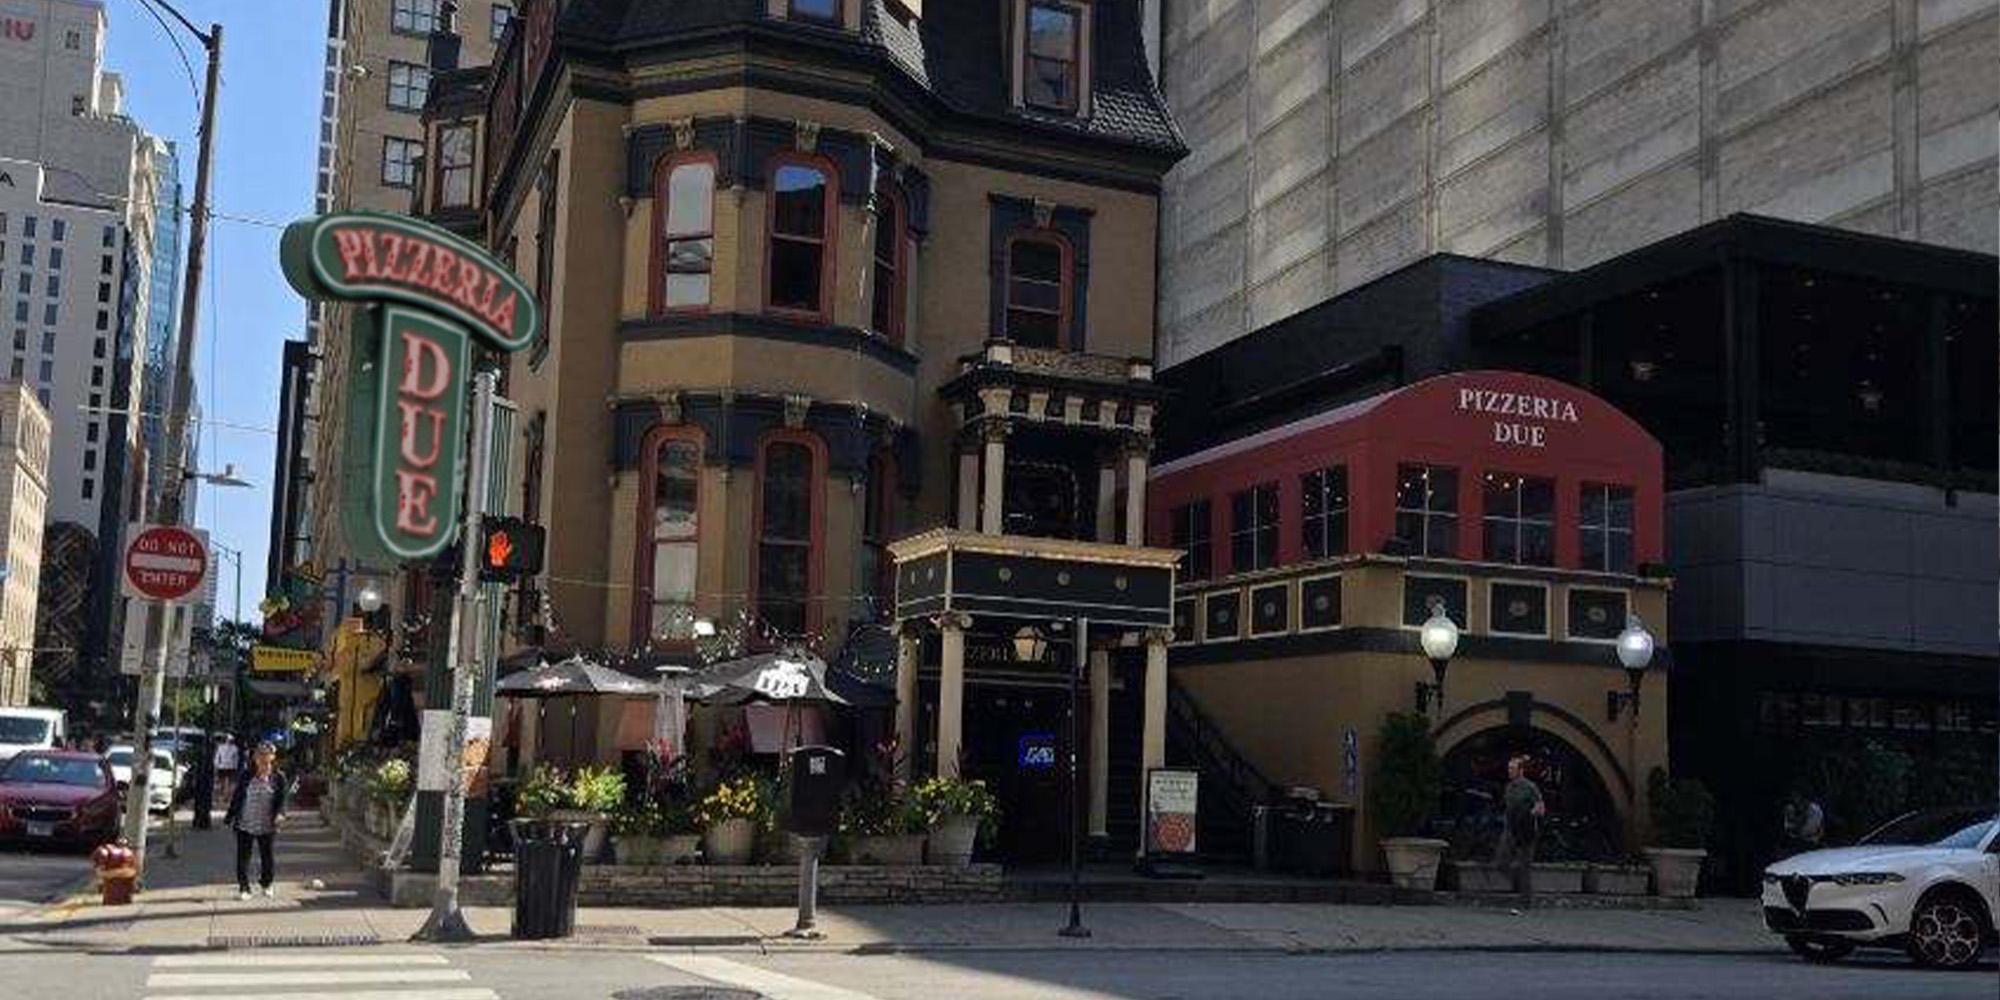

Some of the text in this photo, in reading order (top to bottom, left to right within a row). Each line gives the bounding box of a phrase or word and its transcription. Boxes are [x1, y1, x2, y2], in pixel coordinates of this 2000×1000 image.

[333, 229, 516, 336] PIZZERIA
[1460, 387, 1579, 421] PIZZERIA
[395, 331, 451, 535] DUE
[1494, 421, 1545, 447] DUE
[140, 538, 195, 556] DO NOT
[141, 571, 187, 588] ENTER
